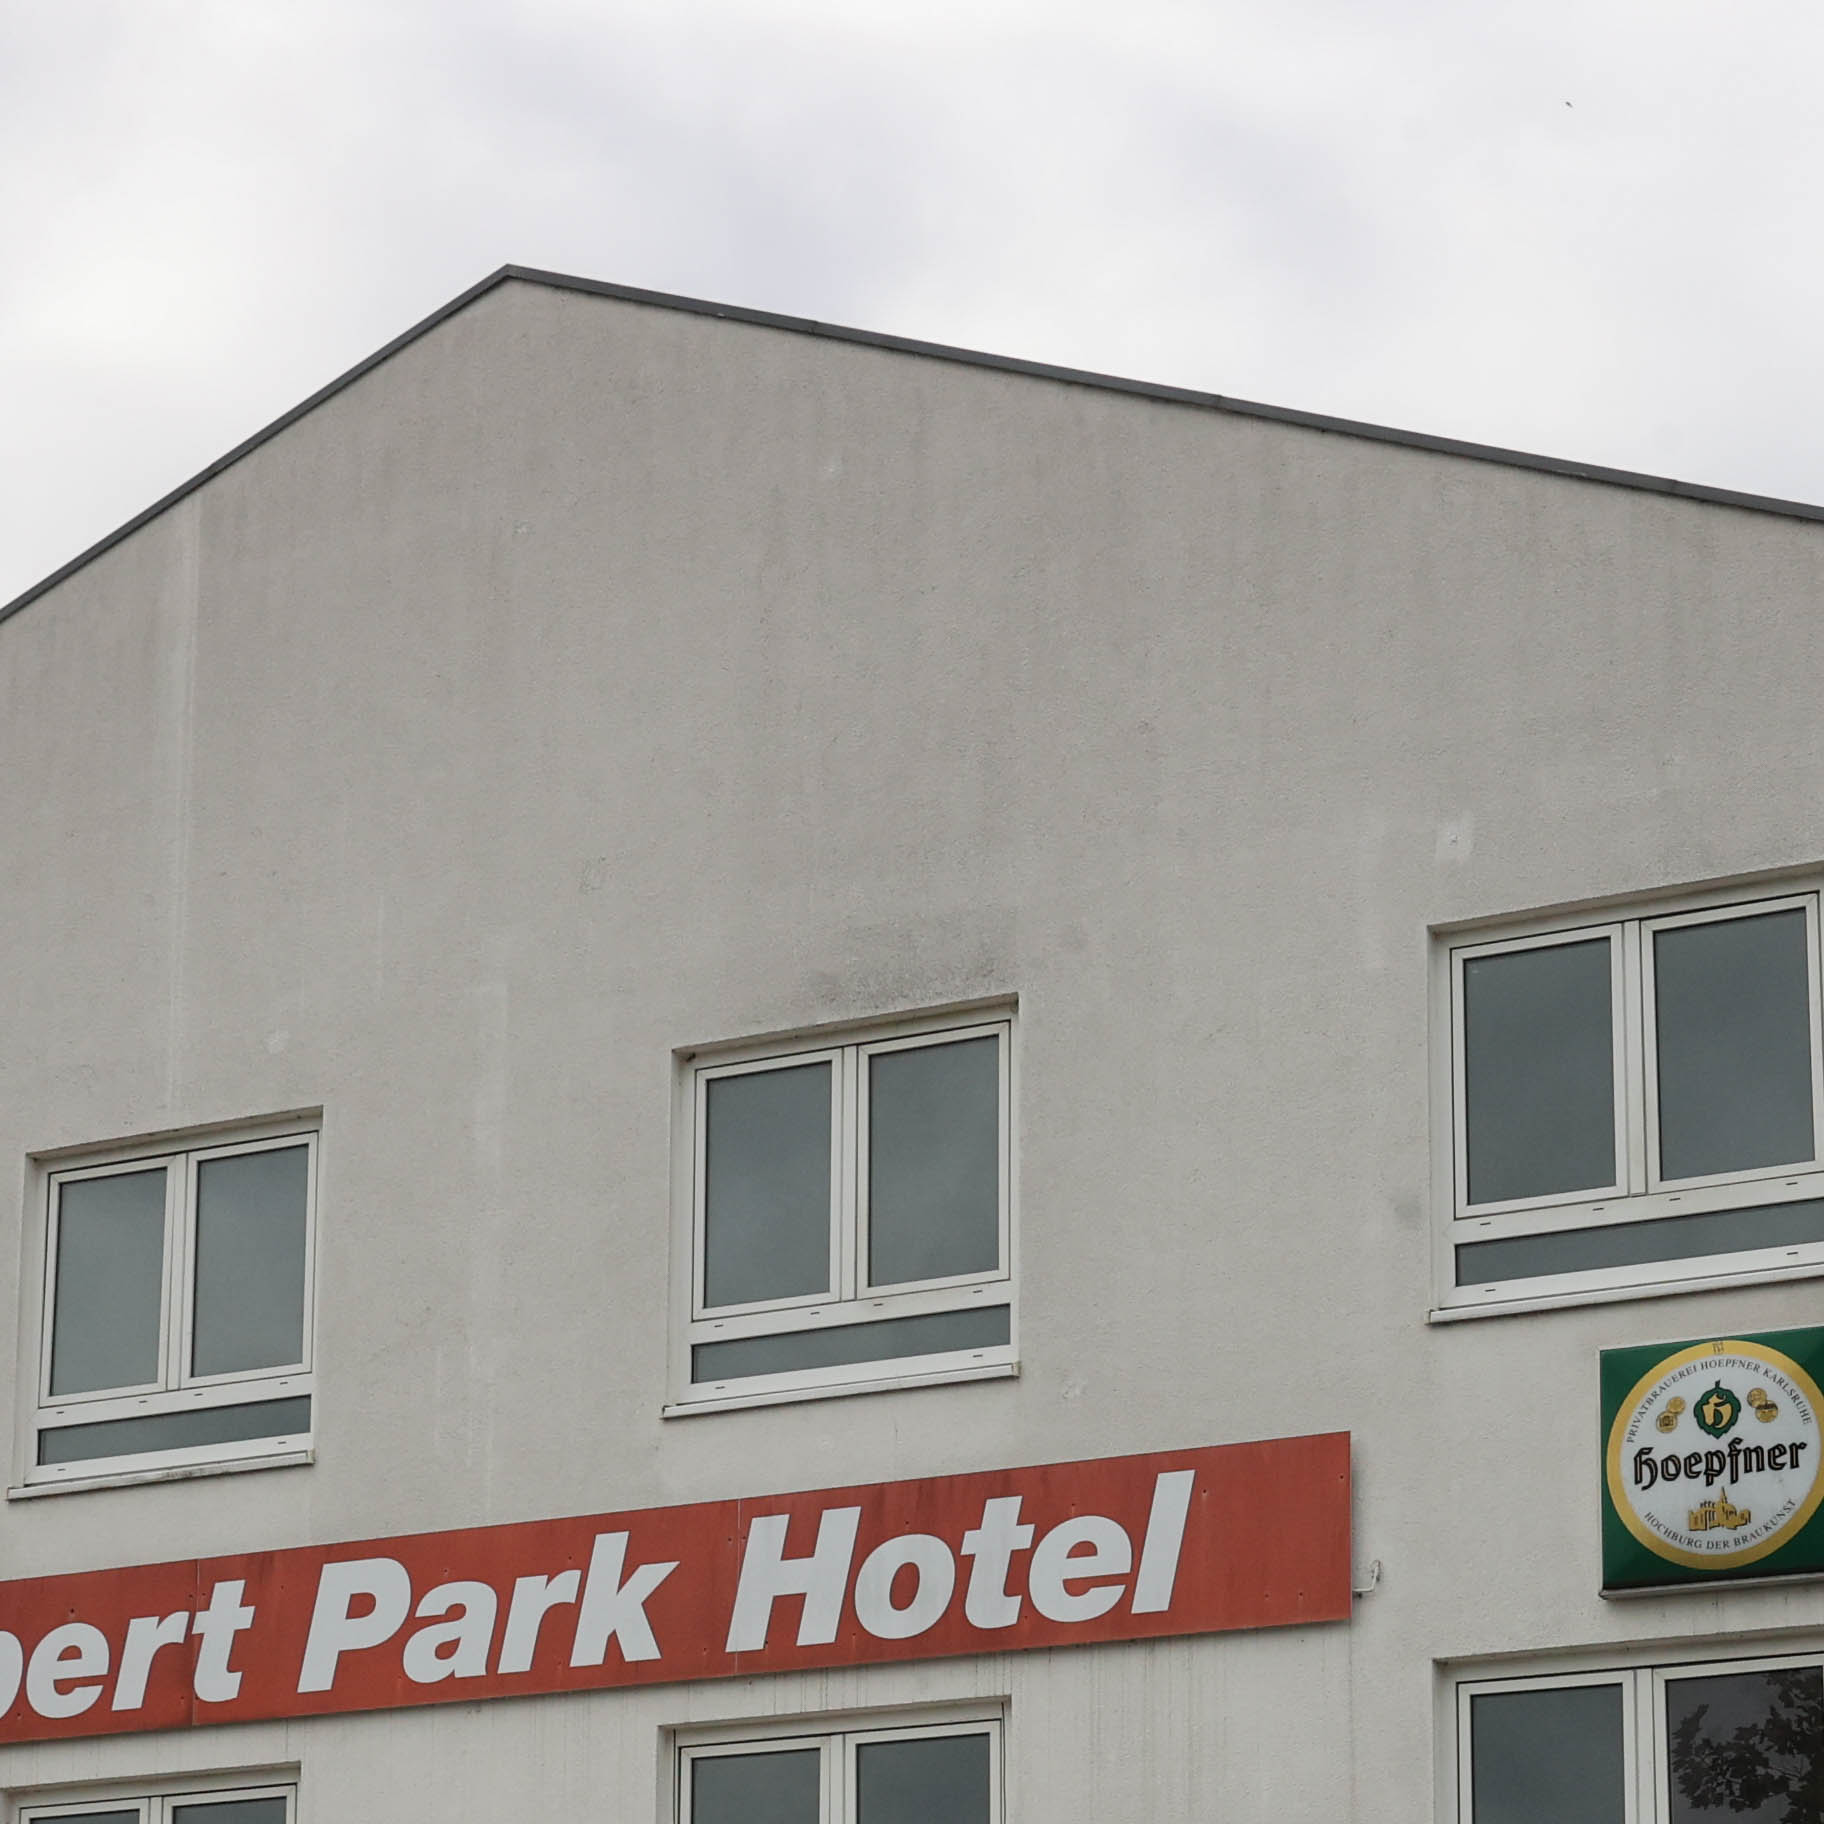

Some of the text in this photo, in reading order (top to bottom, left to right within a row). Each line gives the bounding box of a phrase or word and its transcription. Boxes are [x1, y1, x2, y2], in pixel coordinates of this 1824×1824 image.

[1627, 1358, 1812, 1444] PRIVATBRAUEREI HOEPFNER KARLSRUHE
[1643, 1499, 1797, 1550] HOCHBURG DER BRAUKUNST
[297, 1531, 680, 1693] Park
[725, 1469, 1195, 1653] Hotel
